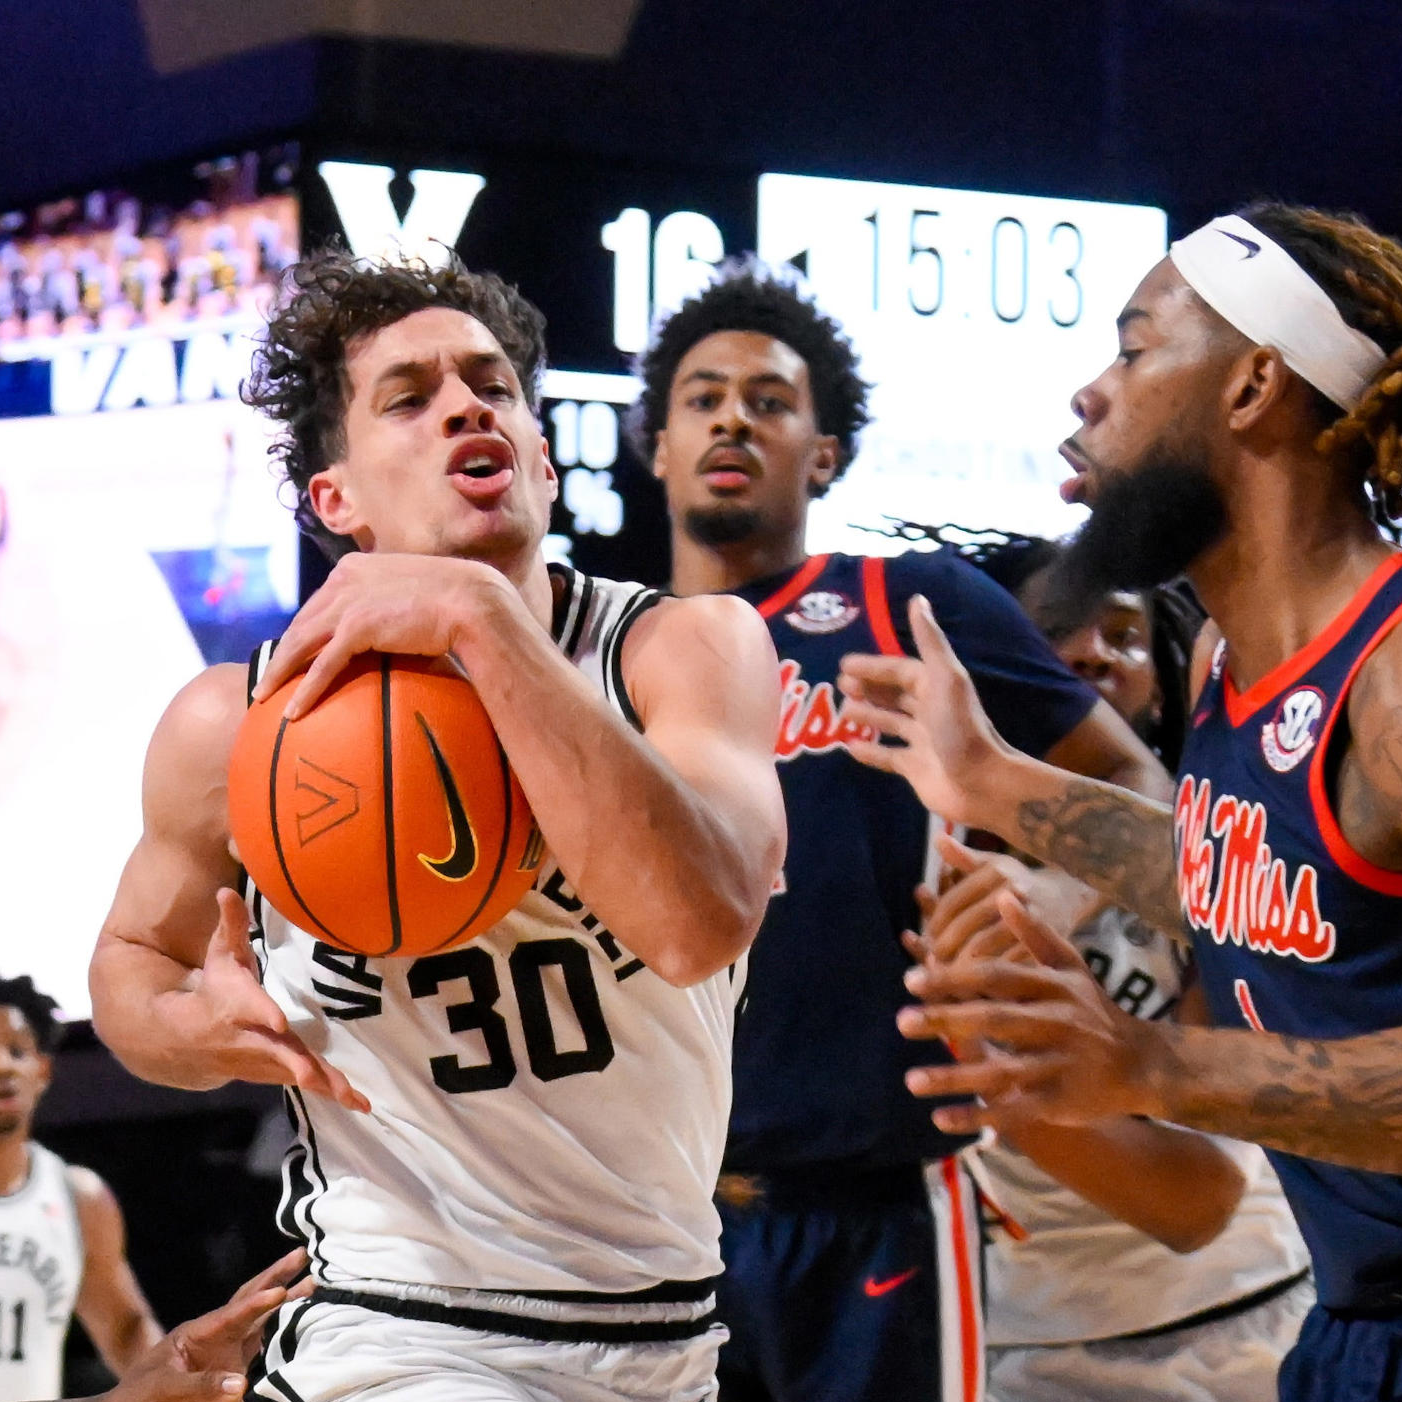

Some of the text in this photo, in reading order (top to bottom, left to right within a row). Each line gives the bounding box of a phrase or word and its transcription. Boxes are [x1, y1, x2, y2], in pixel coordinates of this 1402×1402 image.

[863, 208, 1086, 328] 15:03
[1210, 793, 1337, 963] Miss
[407, 938, 615, 1094] 30
